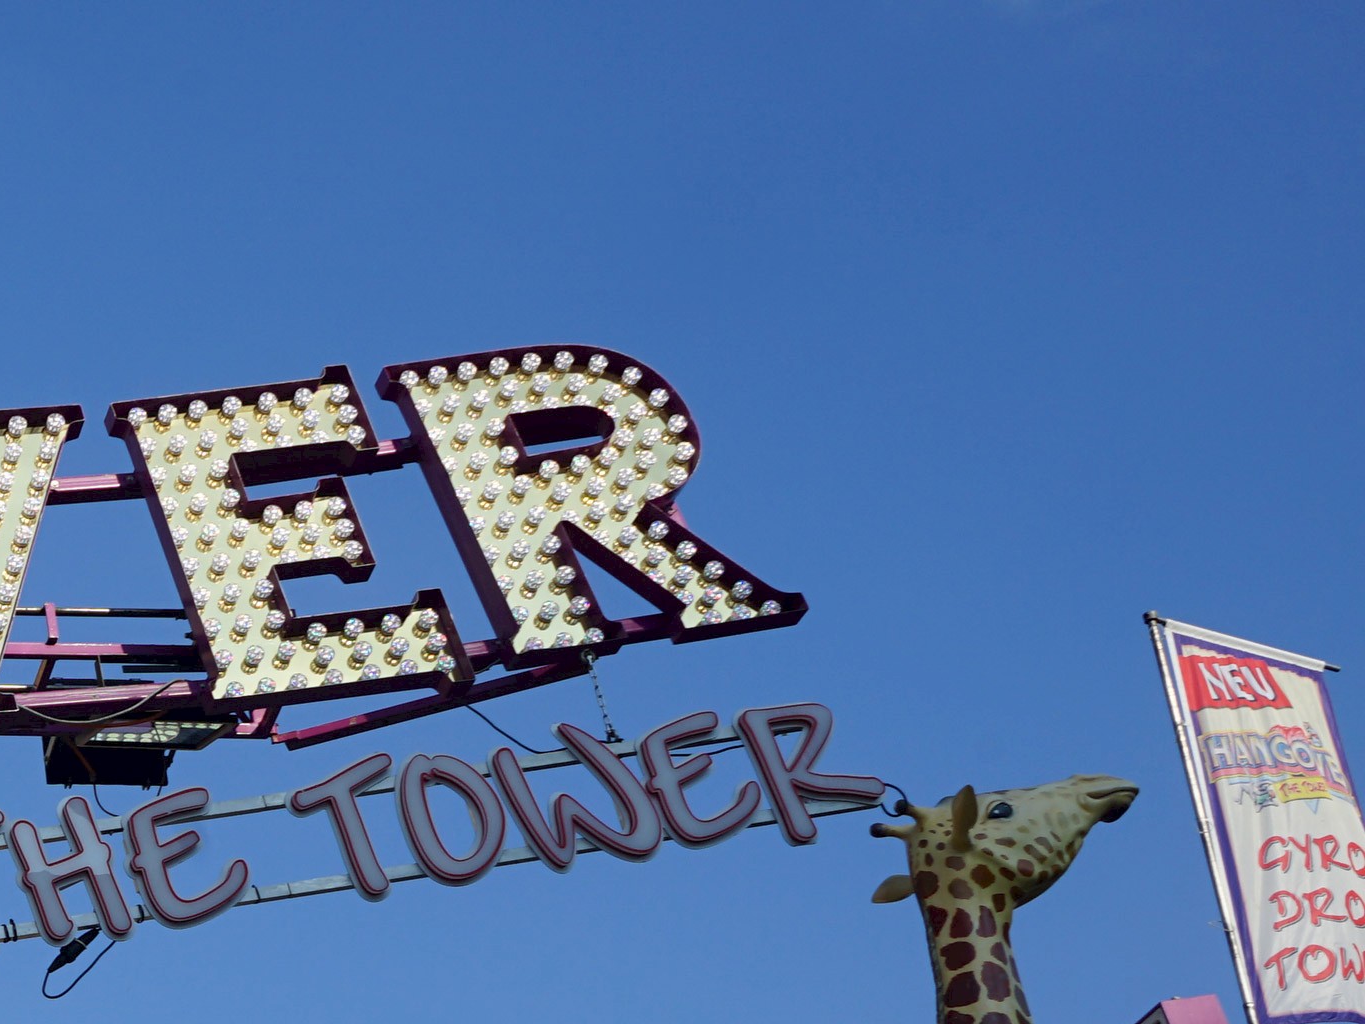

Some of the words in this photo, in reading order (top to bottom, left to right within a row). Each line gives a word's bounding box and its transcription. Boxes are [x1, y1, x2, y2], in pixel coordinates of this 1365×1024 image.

[1198, 663, 1275, 701] NEU
[286, 702, 886, 901] TOWER
[1269, 887, 1365, 932] DRO
[1263, 943, 1365, 991] TOW
